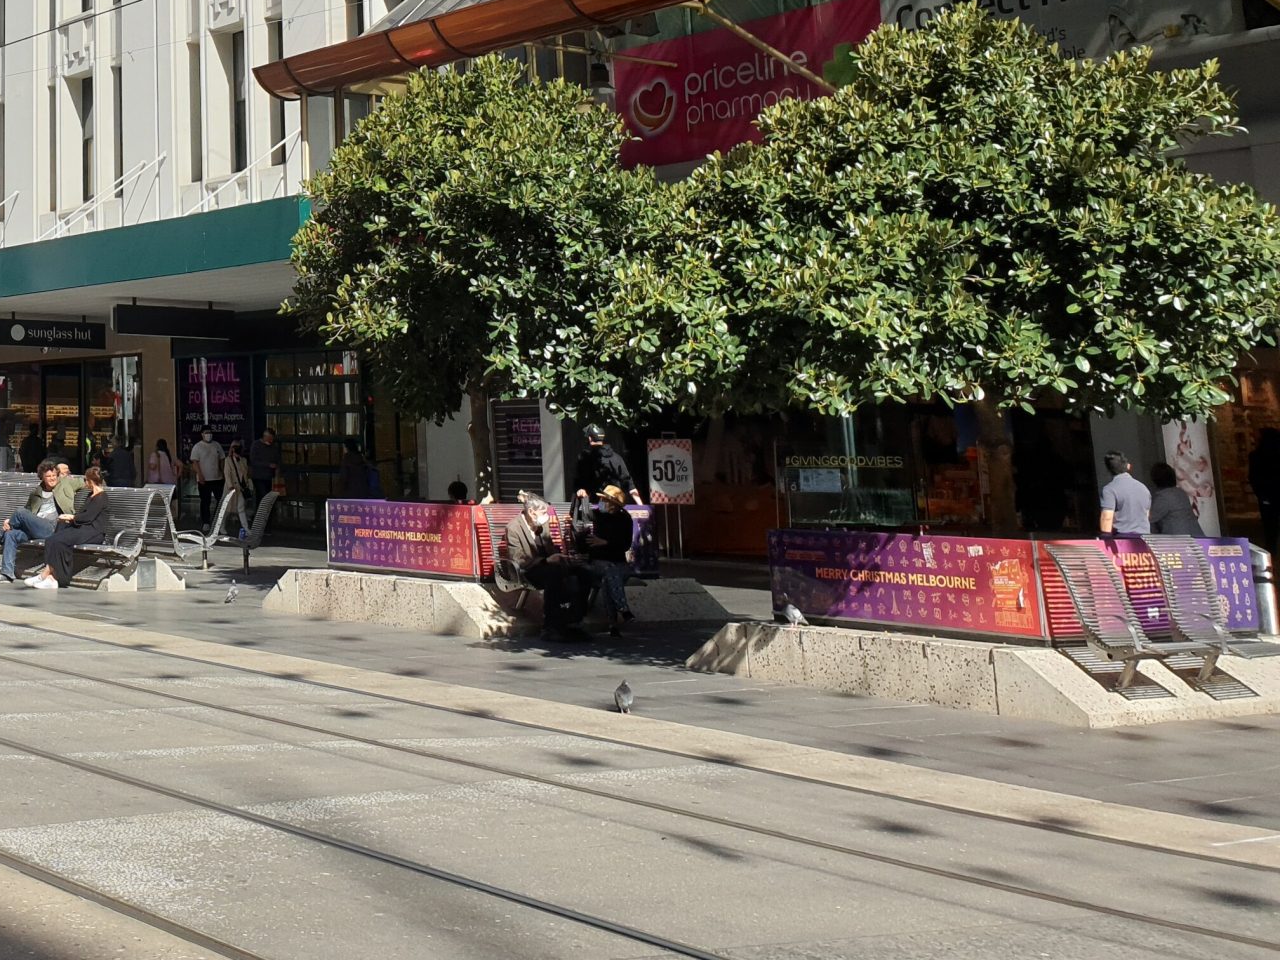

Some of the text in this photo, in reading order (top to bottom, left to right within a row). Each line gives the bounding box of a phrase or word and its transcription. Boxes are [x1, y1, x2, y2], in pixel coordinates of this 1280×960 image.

[684, 50, 808, 104] priceline
[27, 326, 92, 342] sunglass hut
[210, 390, 241, 404] LEASE
[192, 423, 239, 433] AVBLE NOW
[512, 419, 540, 432] RETA
[652, 459, 688, 482] 50%
[354, 527, 442, 543] MERRY CHRISTMAS MELBOURNE
[815, 566, 849, 581] MERRY
[849, 568, 907, 586] CHRISTMAS
[908, 572, 977, 590] MELBOURNE
